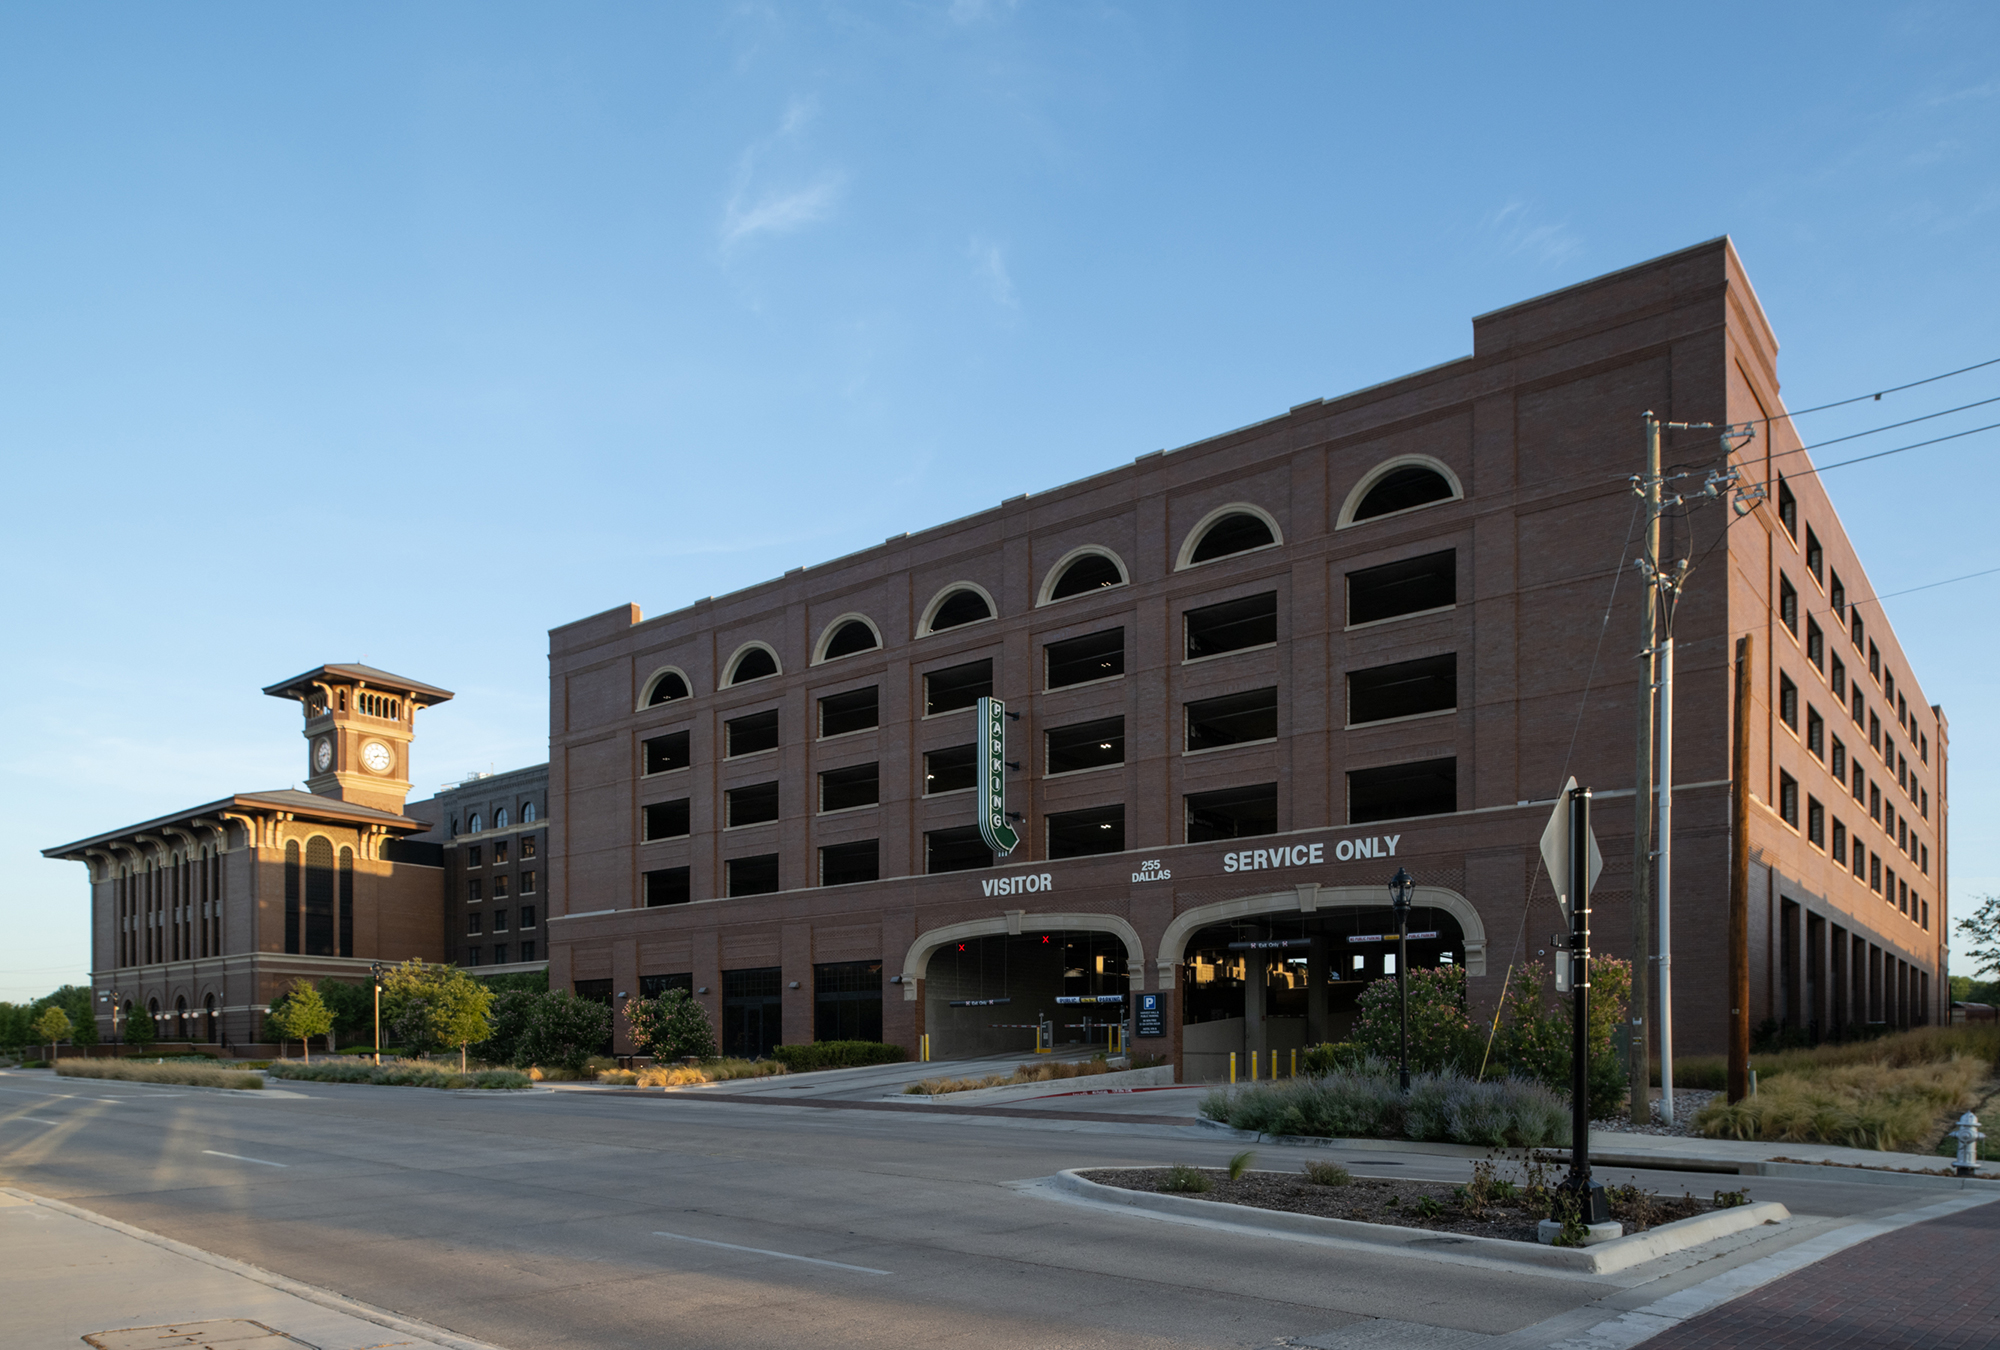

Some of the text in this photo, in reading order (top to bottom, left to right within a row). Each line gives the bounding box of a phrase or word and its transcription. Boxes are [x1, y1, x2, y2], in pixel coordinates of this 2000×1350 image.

[992, 703, 1002, 827] PARKING
[1223, 834, 1401, 873] SERVICE ONLY
[1141, 859, 1161, 871] 255
[981, 873, 1053, 897] VISITOR
[1131, 869, 1171, 883] DALLAS
[1145, 997, 1154, 1008] P
